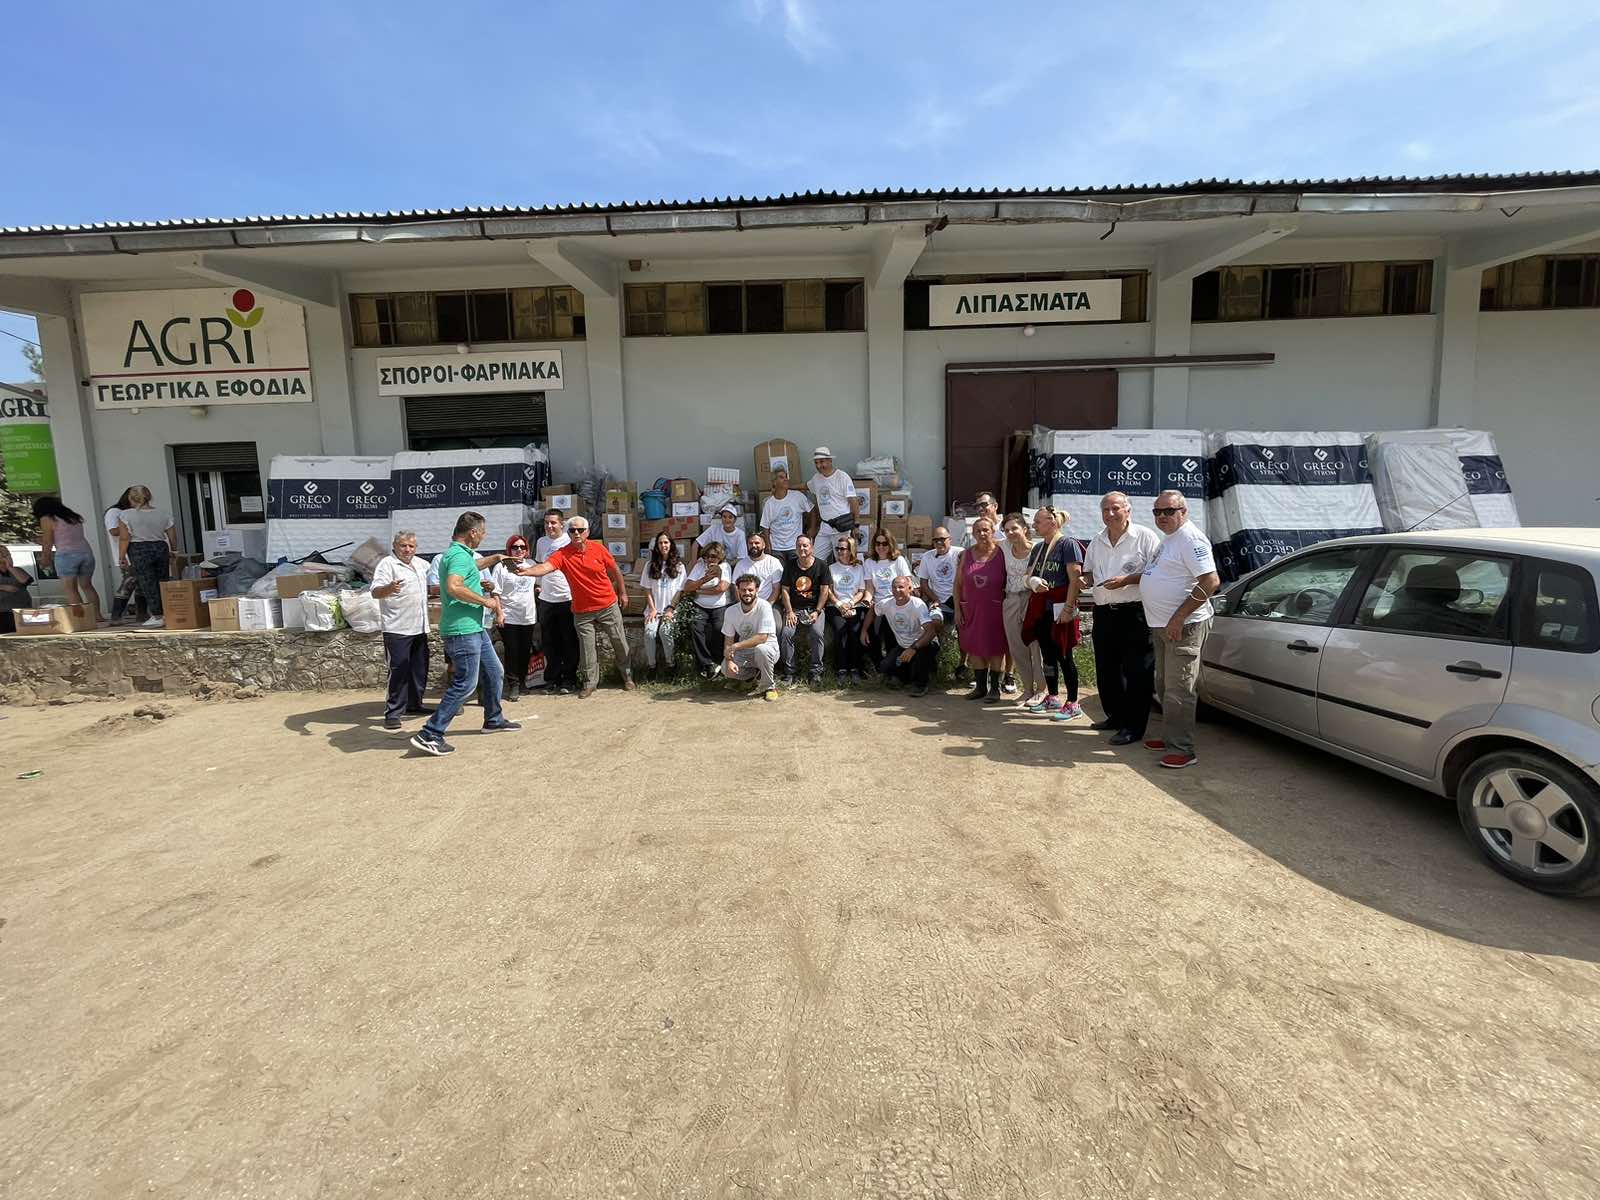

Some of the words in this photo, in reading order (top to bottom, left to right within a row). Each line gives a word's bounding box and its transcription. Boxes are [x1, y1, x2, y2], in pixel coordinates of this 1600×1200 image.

[955, 292, 1091, 314] ΛΙΠΑΣΜΑΤΑ
[380, 361, 561, 385] ΣΠΟΡΟΙ-ΦΑΡΜΑΚΑ
[98, 382, 209, 402] ΓΕΩΡΓΙΚΑ
[216, 378, 306, 398] ΕΦΟΔΙΑ
[1250, 461, 1289, 471] GRECO
[1303, 461, 1344, 471] GRECO
[1051, 470, 1091, 481] GRECO
[1107, 471, 1152, 482] GRECO
[408, 484, 446, 497] GRECO
[460, 480, 498, 493] GRECO
[290, 495, 331, 504] GRECO
[346, 495, 387, 504] GRECO
